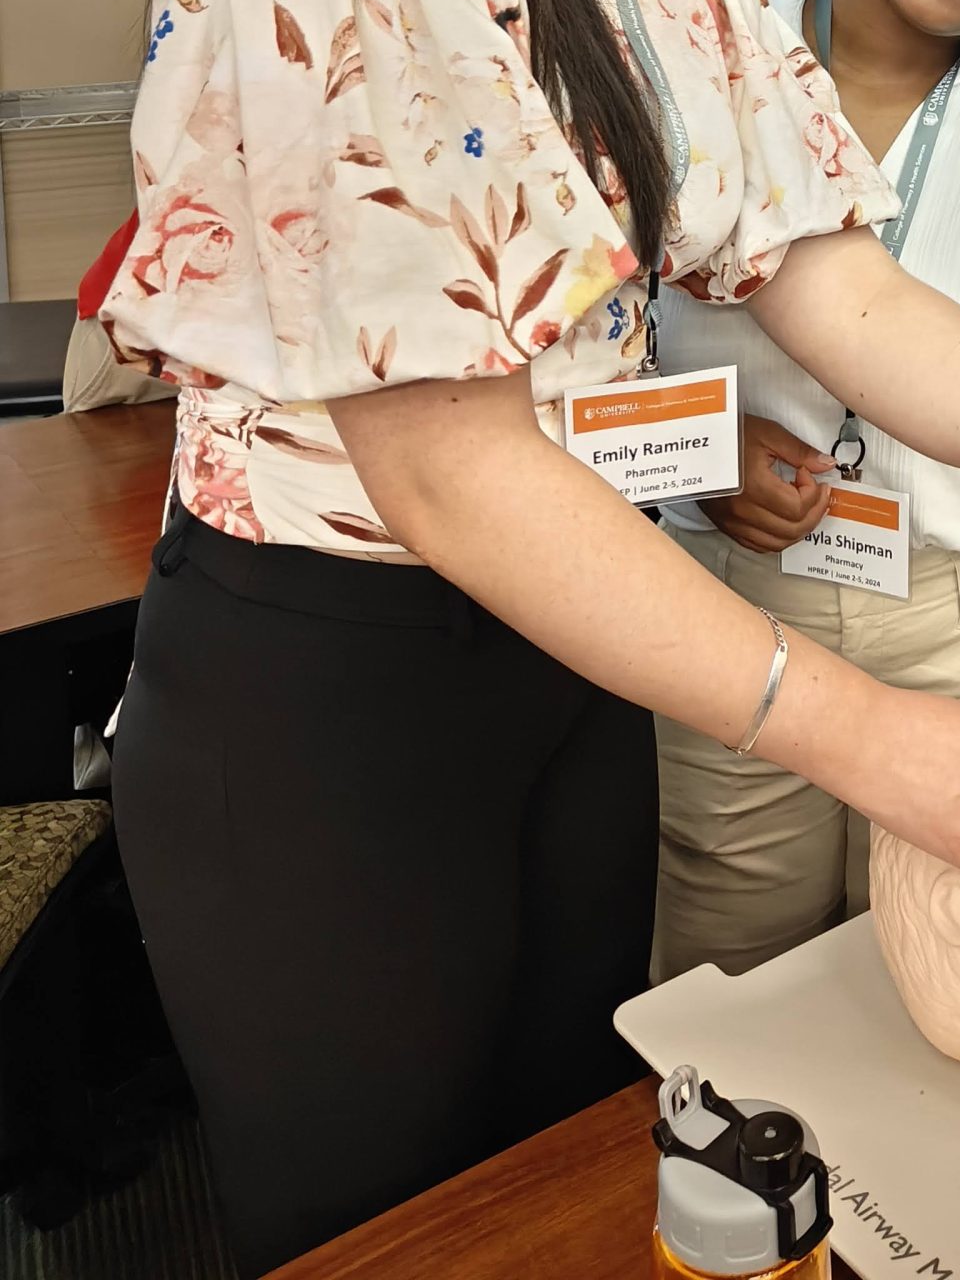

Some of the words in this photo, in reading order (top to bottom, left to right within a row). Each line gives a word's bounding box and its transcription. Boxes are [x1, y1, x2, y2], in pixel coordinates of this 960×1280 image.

[596, 402, 640, 414] CAMPBELL
[593, 446, 638, 464] Emily
[643, 436, 710, 456] Ramirez
[626, 464, 678, 480] Pharmacy
[640, 483, 660, 494] June
[662, 480, 680, 490] 2-5,
[681, 476, 702, 486] 2024
[801, 531, 831, 546] ayla
[836, 534, 892, 559] Shipman
[826, 555, 864, 570] Pharmacy
[808, 566, 828, 576] HPREP
[835, 572, 850, 581] June
[852, 575, 864, 584] 2-5,
[866, 578, 881, 588] 2024
[841, 1192, 920, 1260] Airway
